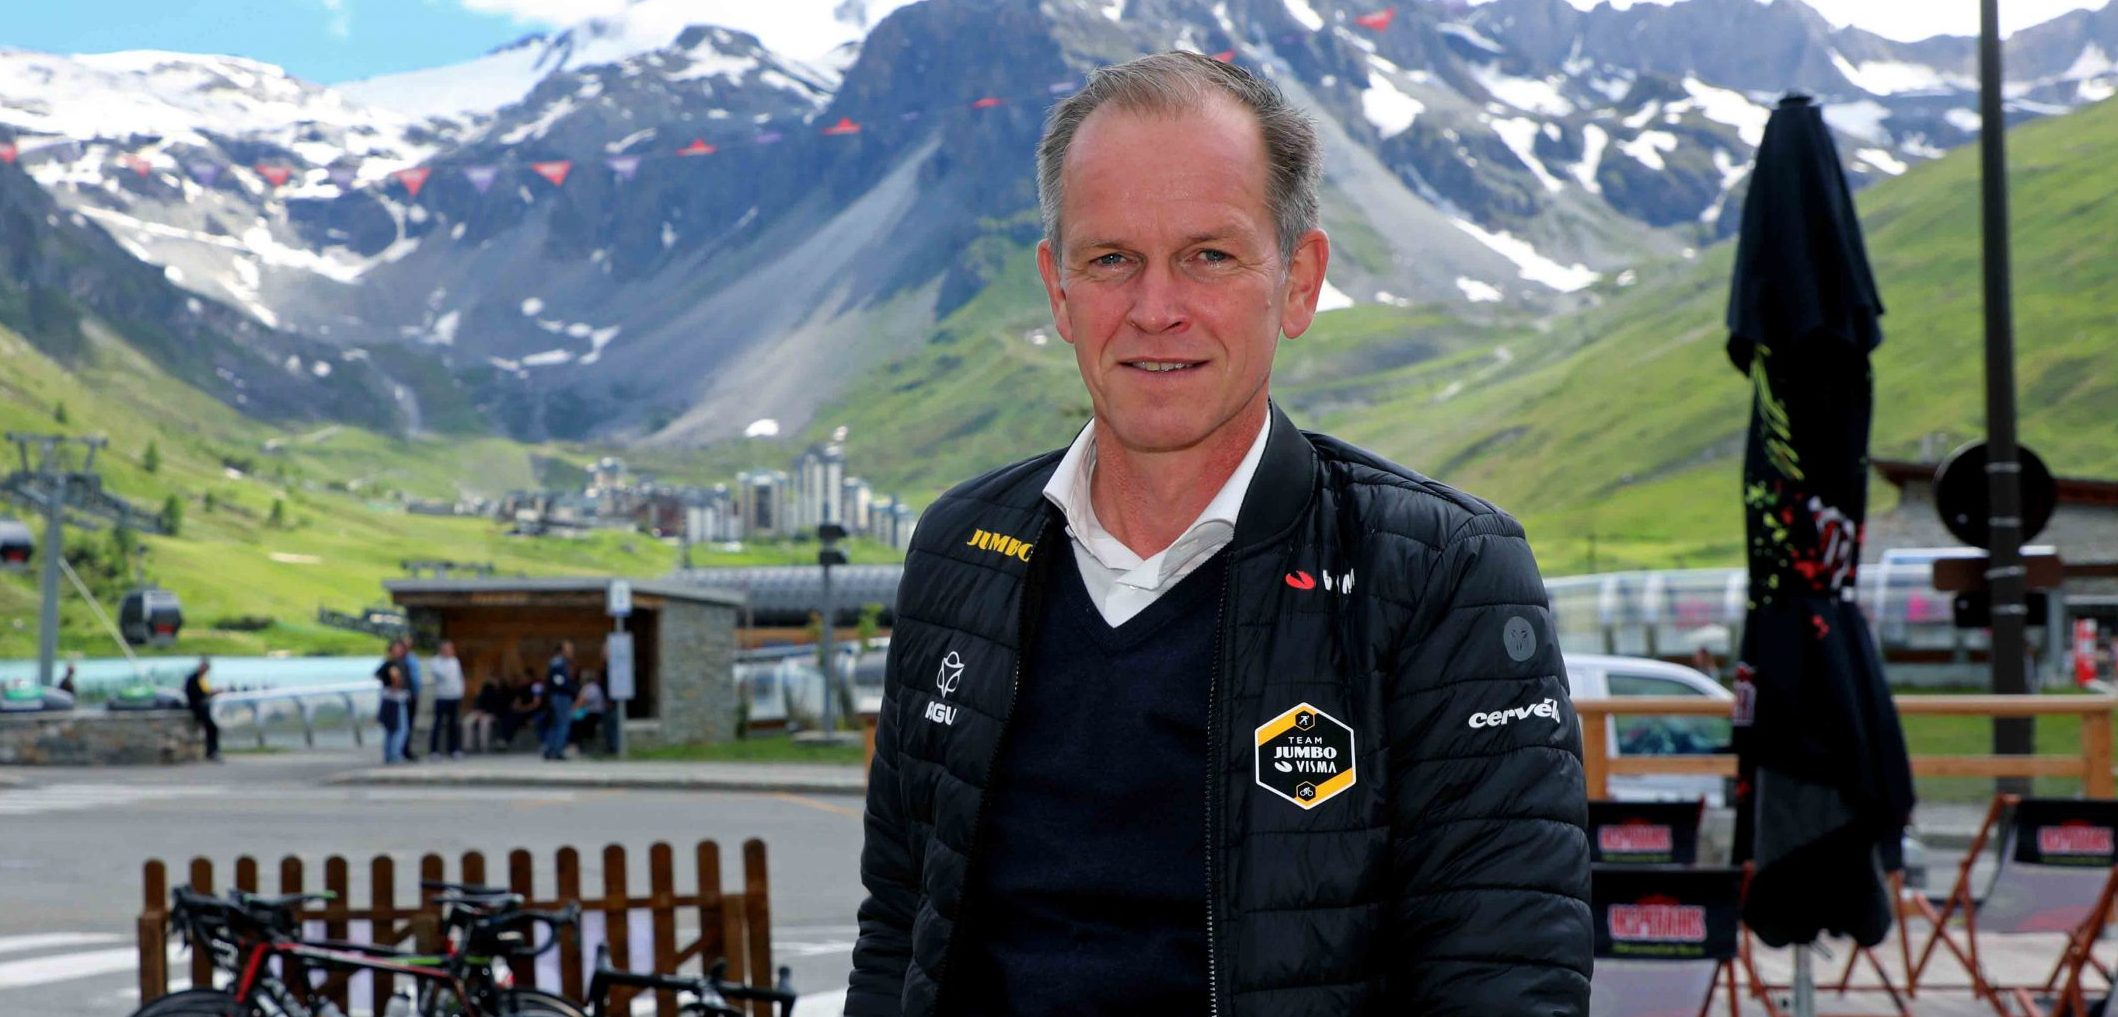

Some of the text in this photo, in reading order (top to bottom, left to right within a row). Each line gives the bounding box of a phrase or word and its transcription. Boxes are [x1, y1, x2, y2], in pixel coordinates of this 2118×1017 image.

[925, 701, 957, 725] AGU
[1288, 736, 1323, 744] TEAM
[1273, 746, 1337, 759] JUMBO
[1296, 760, 1337, 773] VISMA
